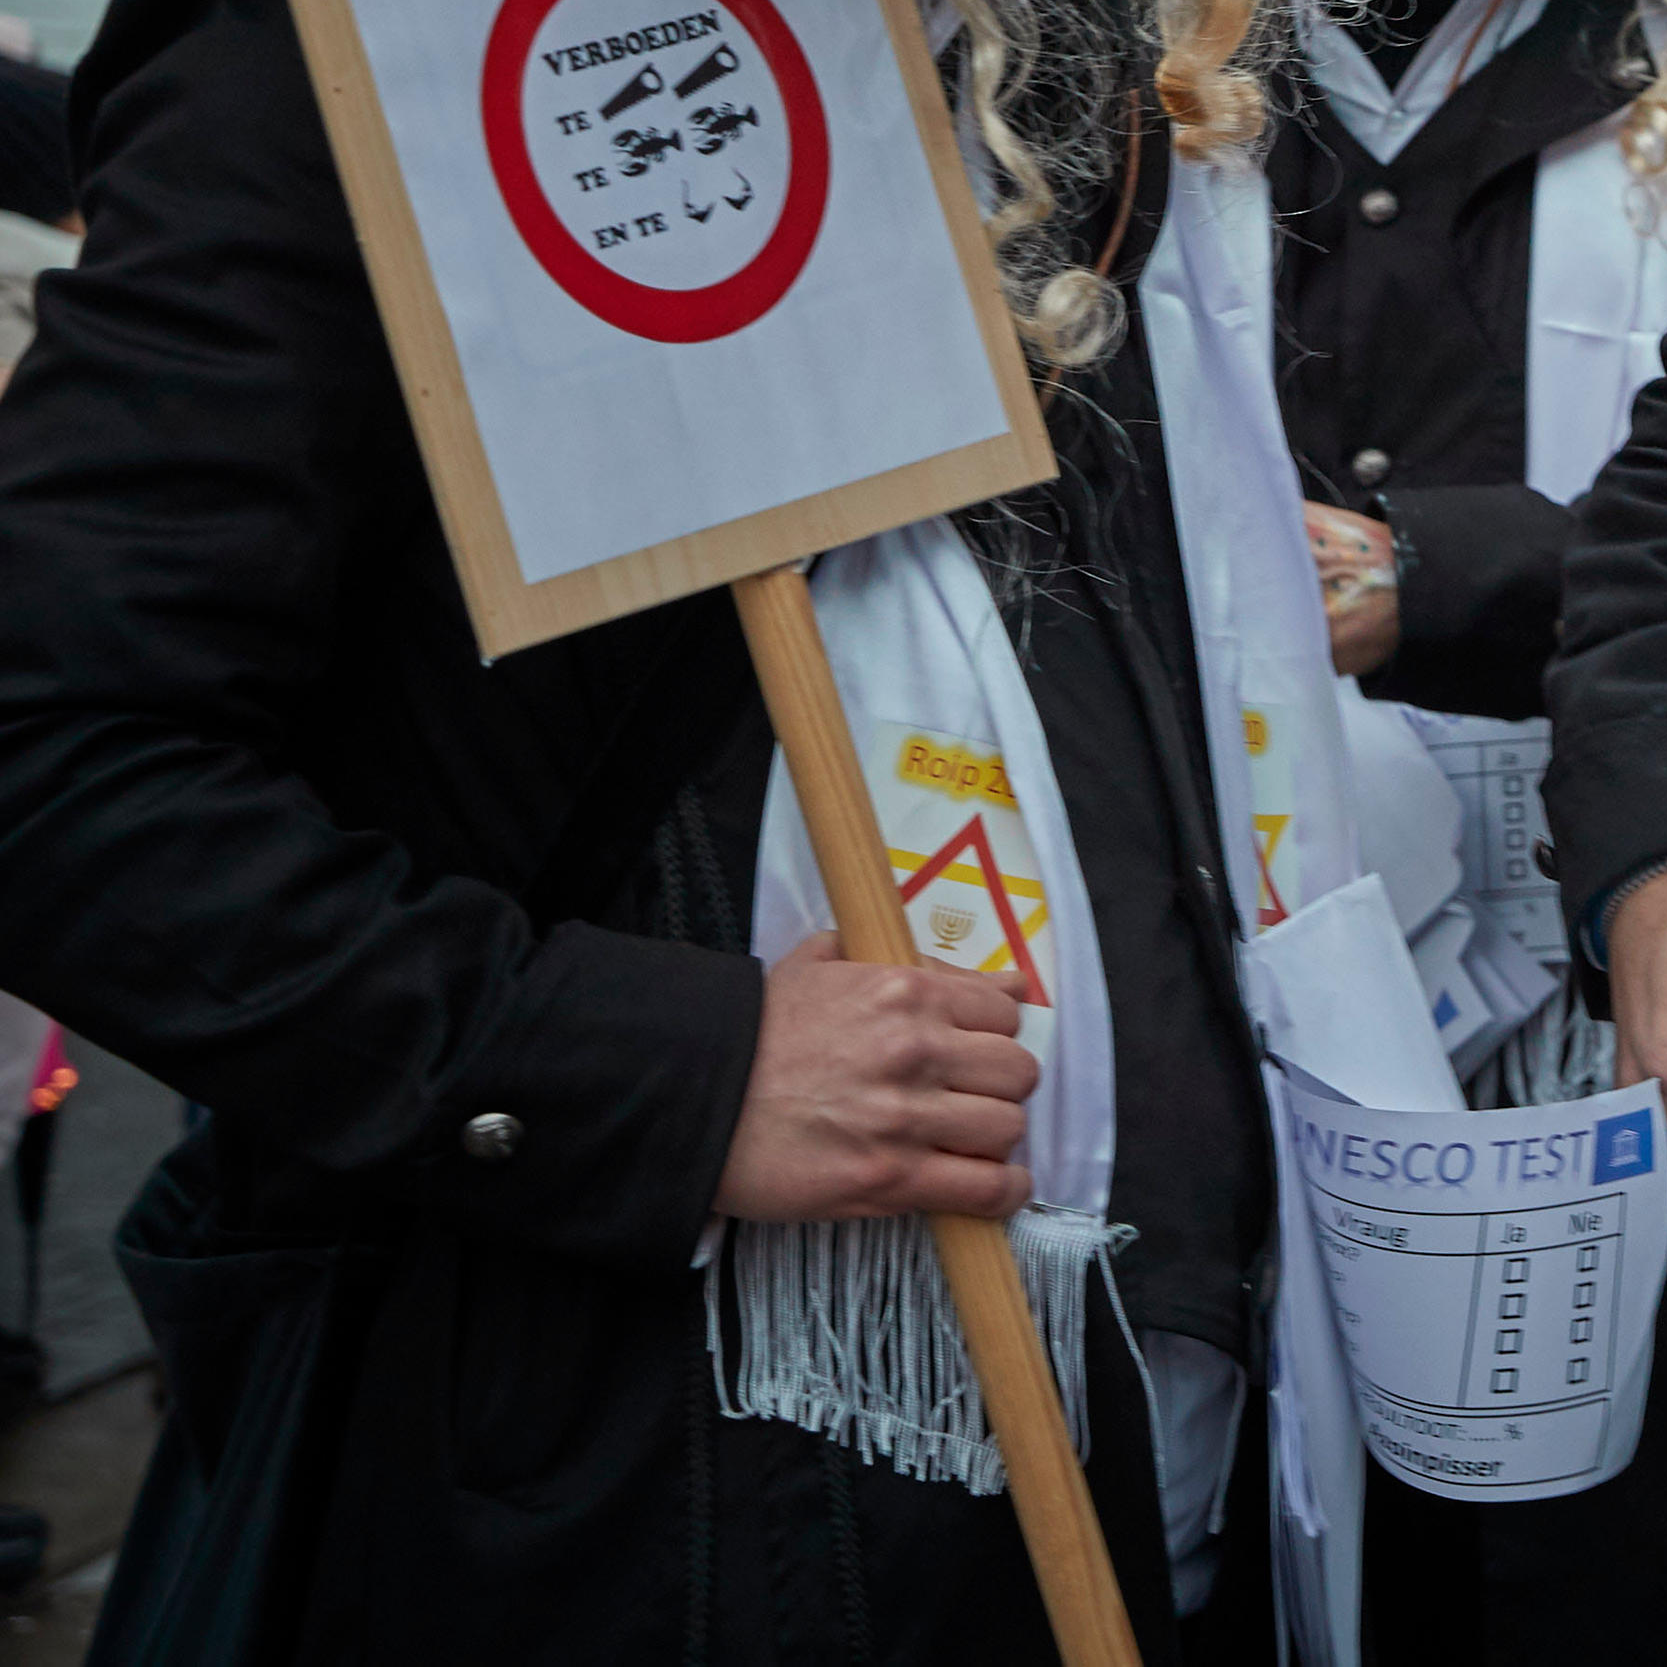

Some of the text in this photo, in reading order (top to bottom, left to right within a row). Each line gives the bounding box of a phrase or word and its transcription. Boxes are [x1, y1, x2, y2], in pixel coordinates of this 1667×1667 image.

[541, 9, 723, 76] VERBOEDEN
[555, 109, 594, 136] TE
[573, 165, 611, 192] TE
[592, 212, 670, 250] EN TE
[905, 745, 981, 792] Roip
[1489, 1129, 1592, 1184] TEST
[1332, 1206, 1411, 1249] Vraug
[1501, 1222, 1528, 1245] Ja
[1568, 1210, 1604, 1235] Nie
